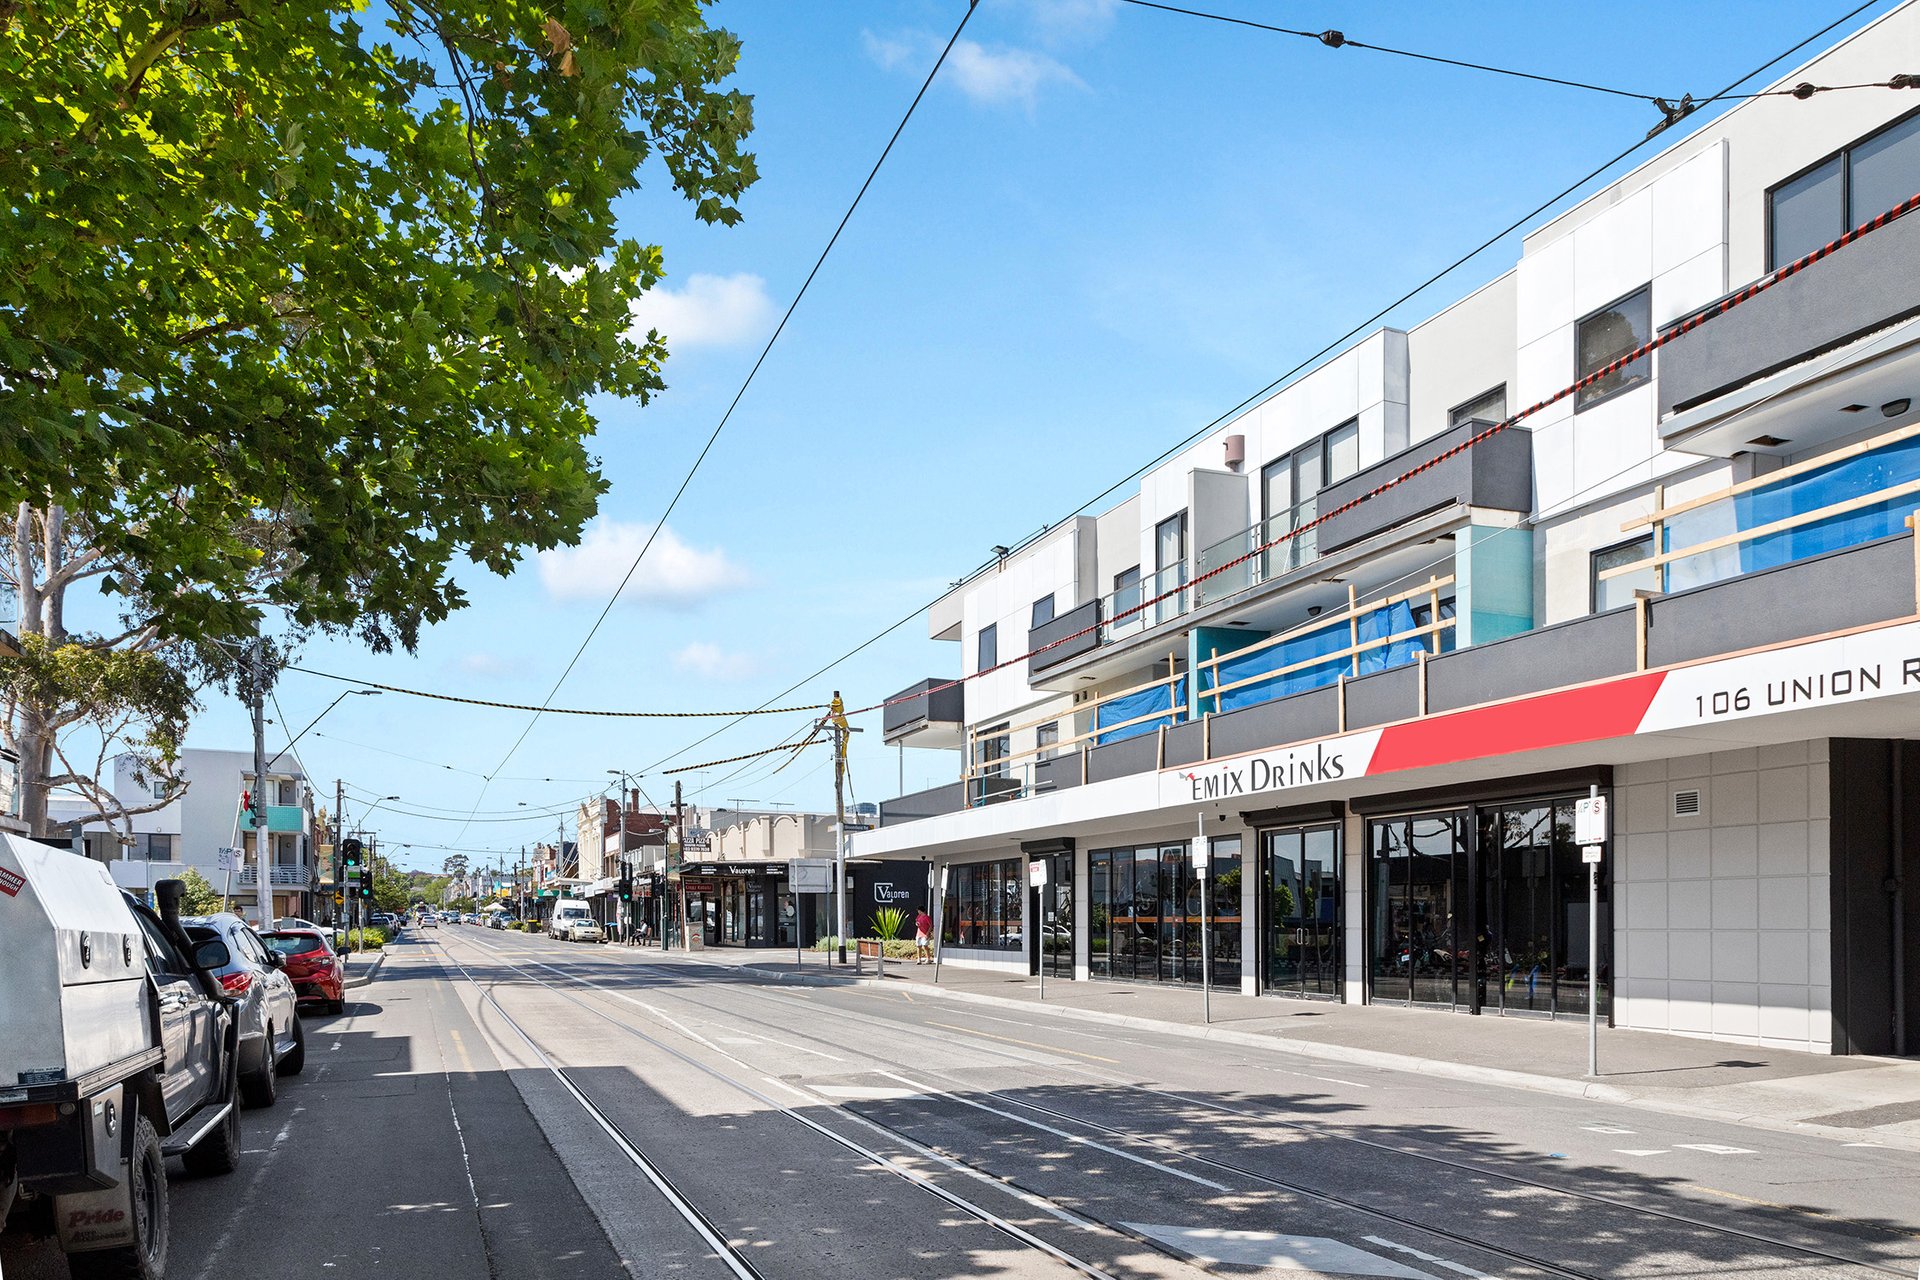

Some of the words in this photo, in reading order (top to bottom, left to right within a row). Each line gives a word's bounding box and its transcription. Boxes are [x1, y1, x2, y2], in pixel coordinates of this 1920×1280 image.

[1696, 687, 1750, 717] 106
[1768, 665, 1881, 706] UNION
[1903, 657, 1920, 685] R
